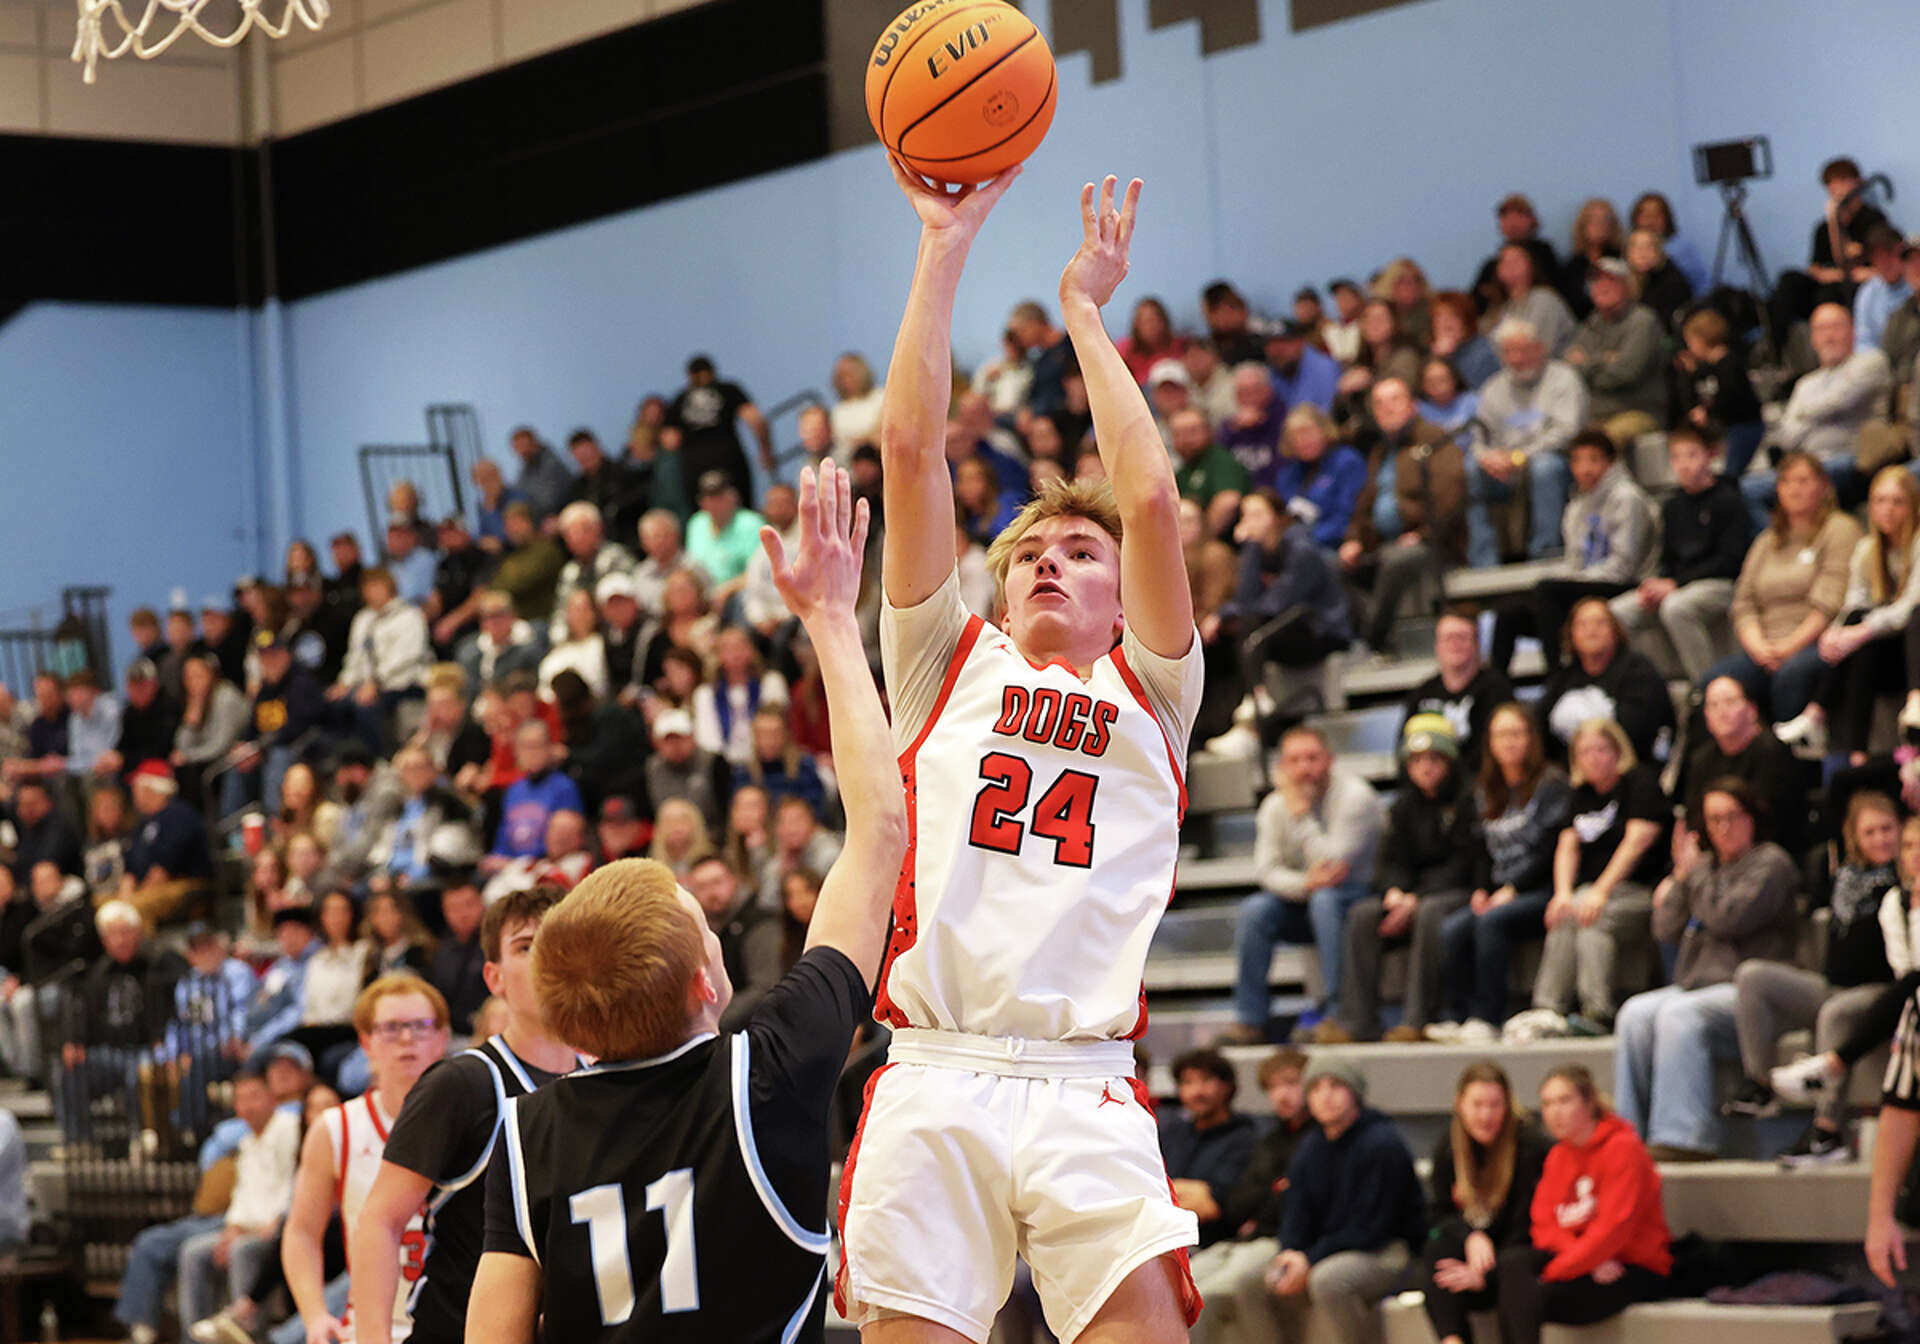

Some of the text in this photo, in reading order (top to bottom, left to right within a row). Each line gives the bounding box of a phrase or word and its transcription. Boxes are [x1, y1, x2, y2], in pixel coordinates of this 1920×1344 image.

[928, 23, 989, 79] EVO
[992, 685, 1119, 757] DOGS
[968, 751, 1100, 869] 24
[569, 1167, 700, 1326] 11
